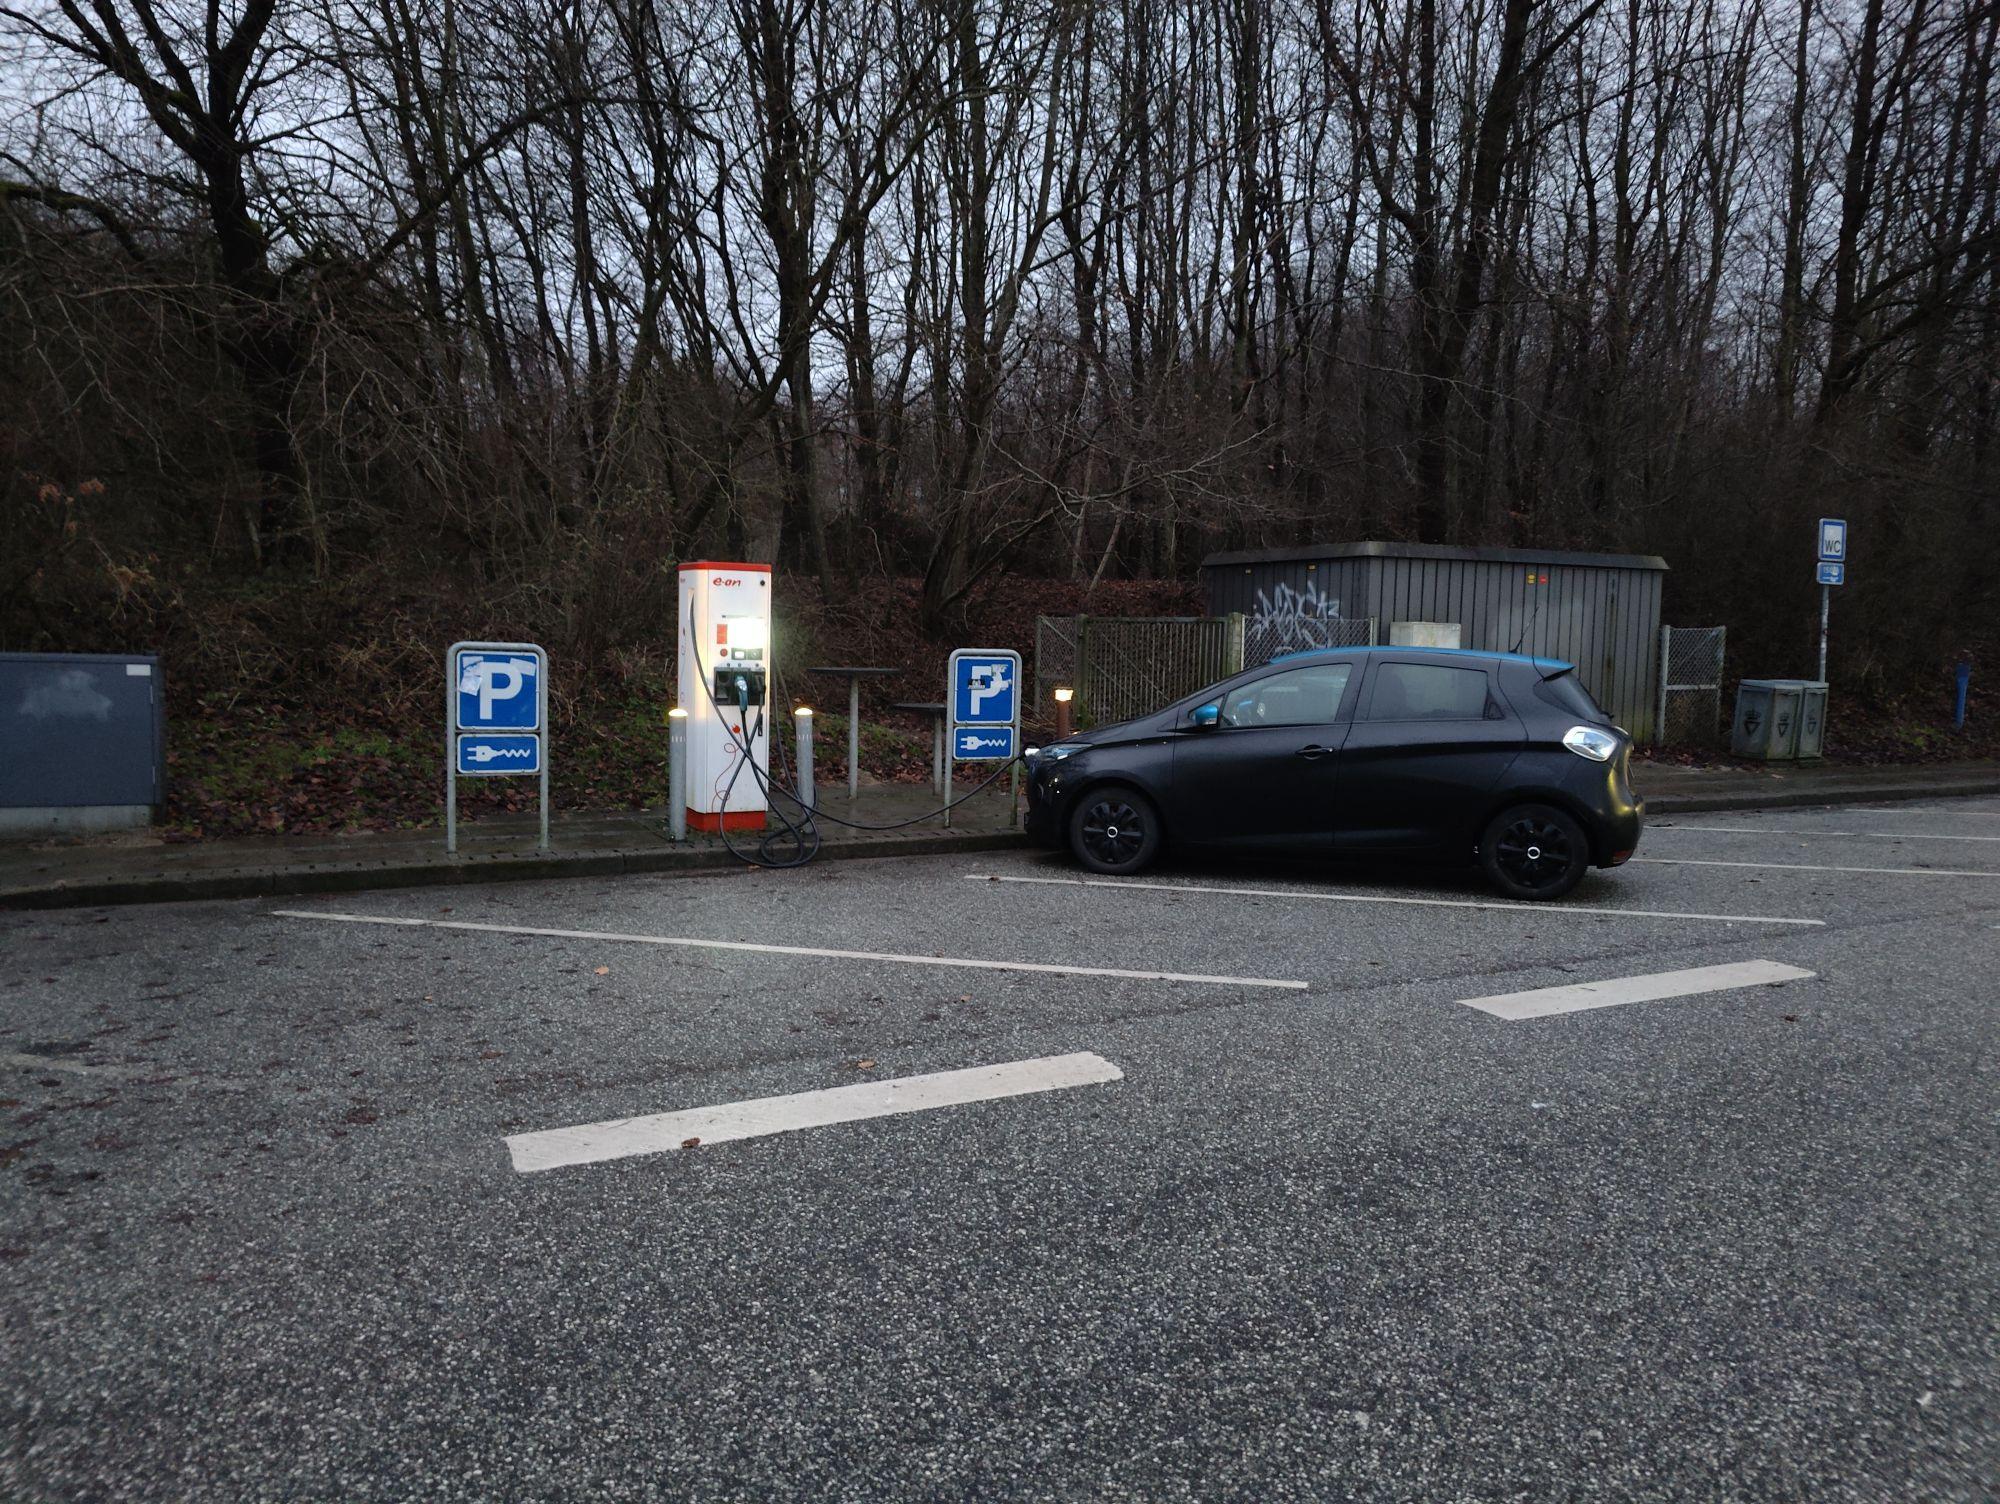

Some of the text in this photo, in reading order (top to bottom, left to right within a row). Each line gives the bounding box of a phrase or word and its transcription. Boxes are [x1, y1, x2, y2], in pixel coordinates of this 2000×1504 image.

[1825, 540, 1841, 553] WC
[480, 662, 522, 720] P
[970, 665, 1002, 715] P
